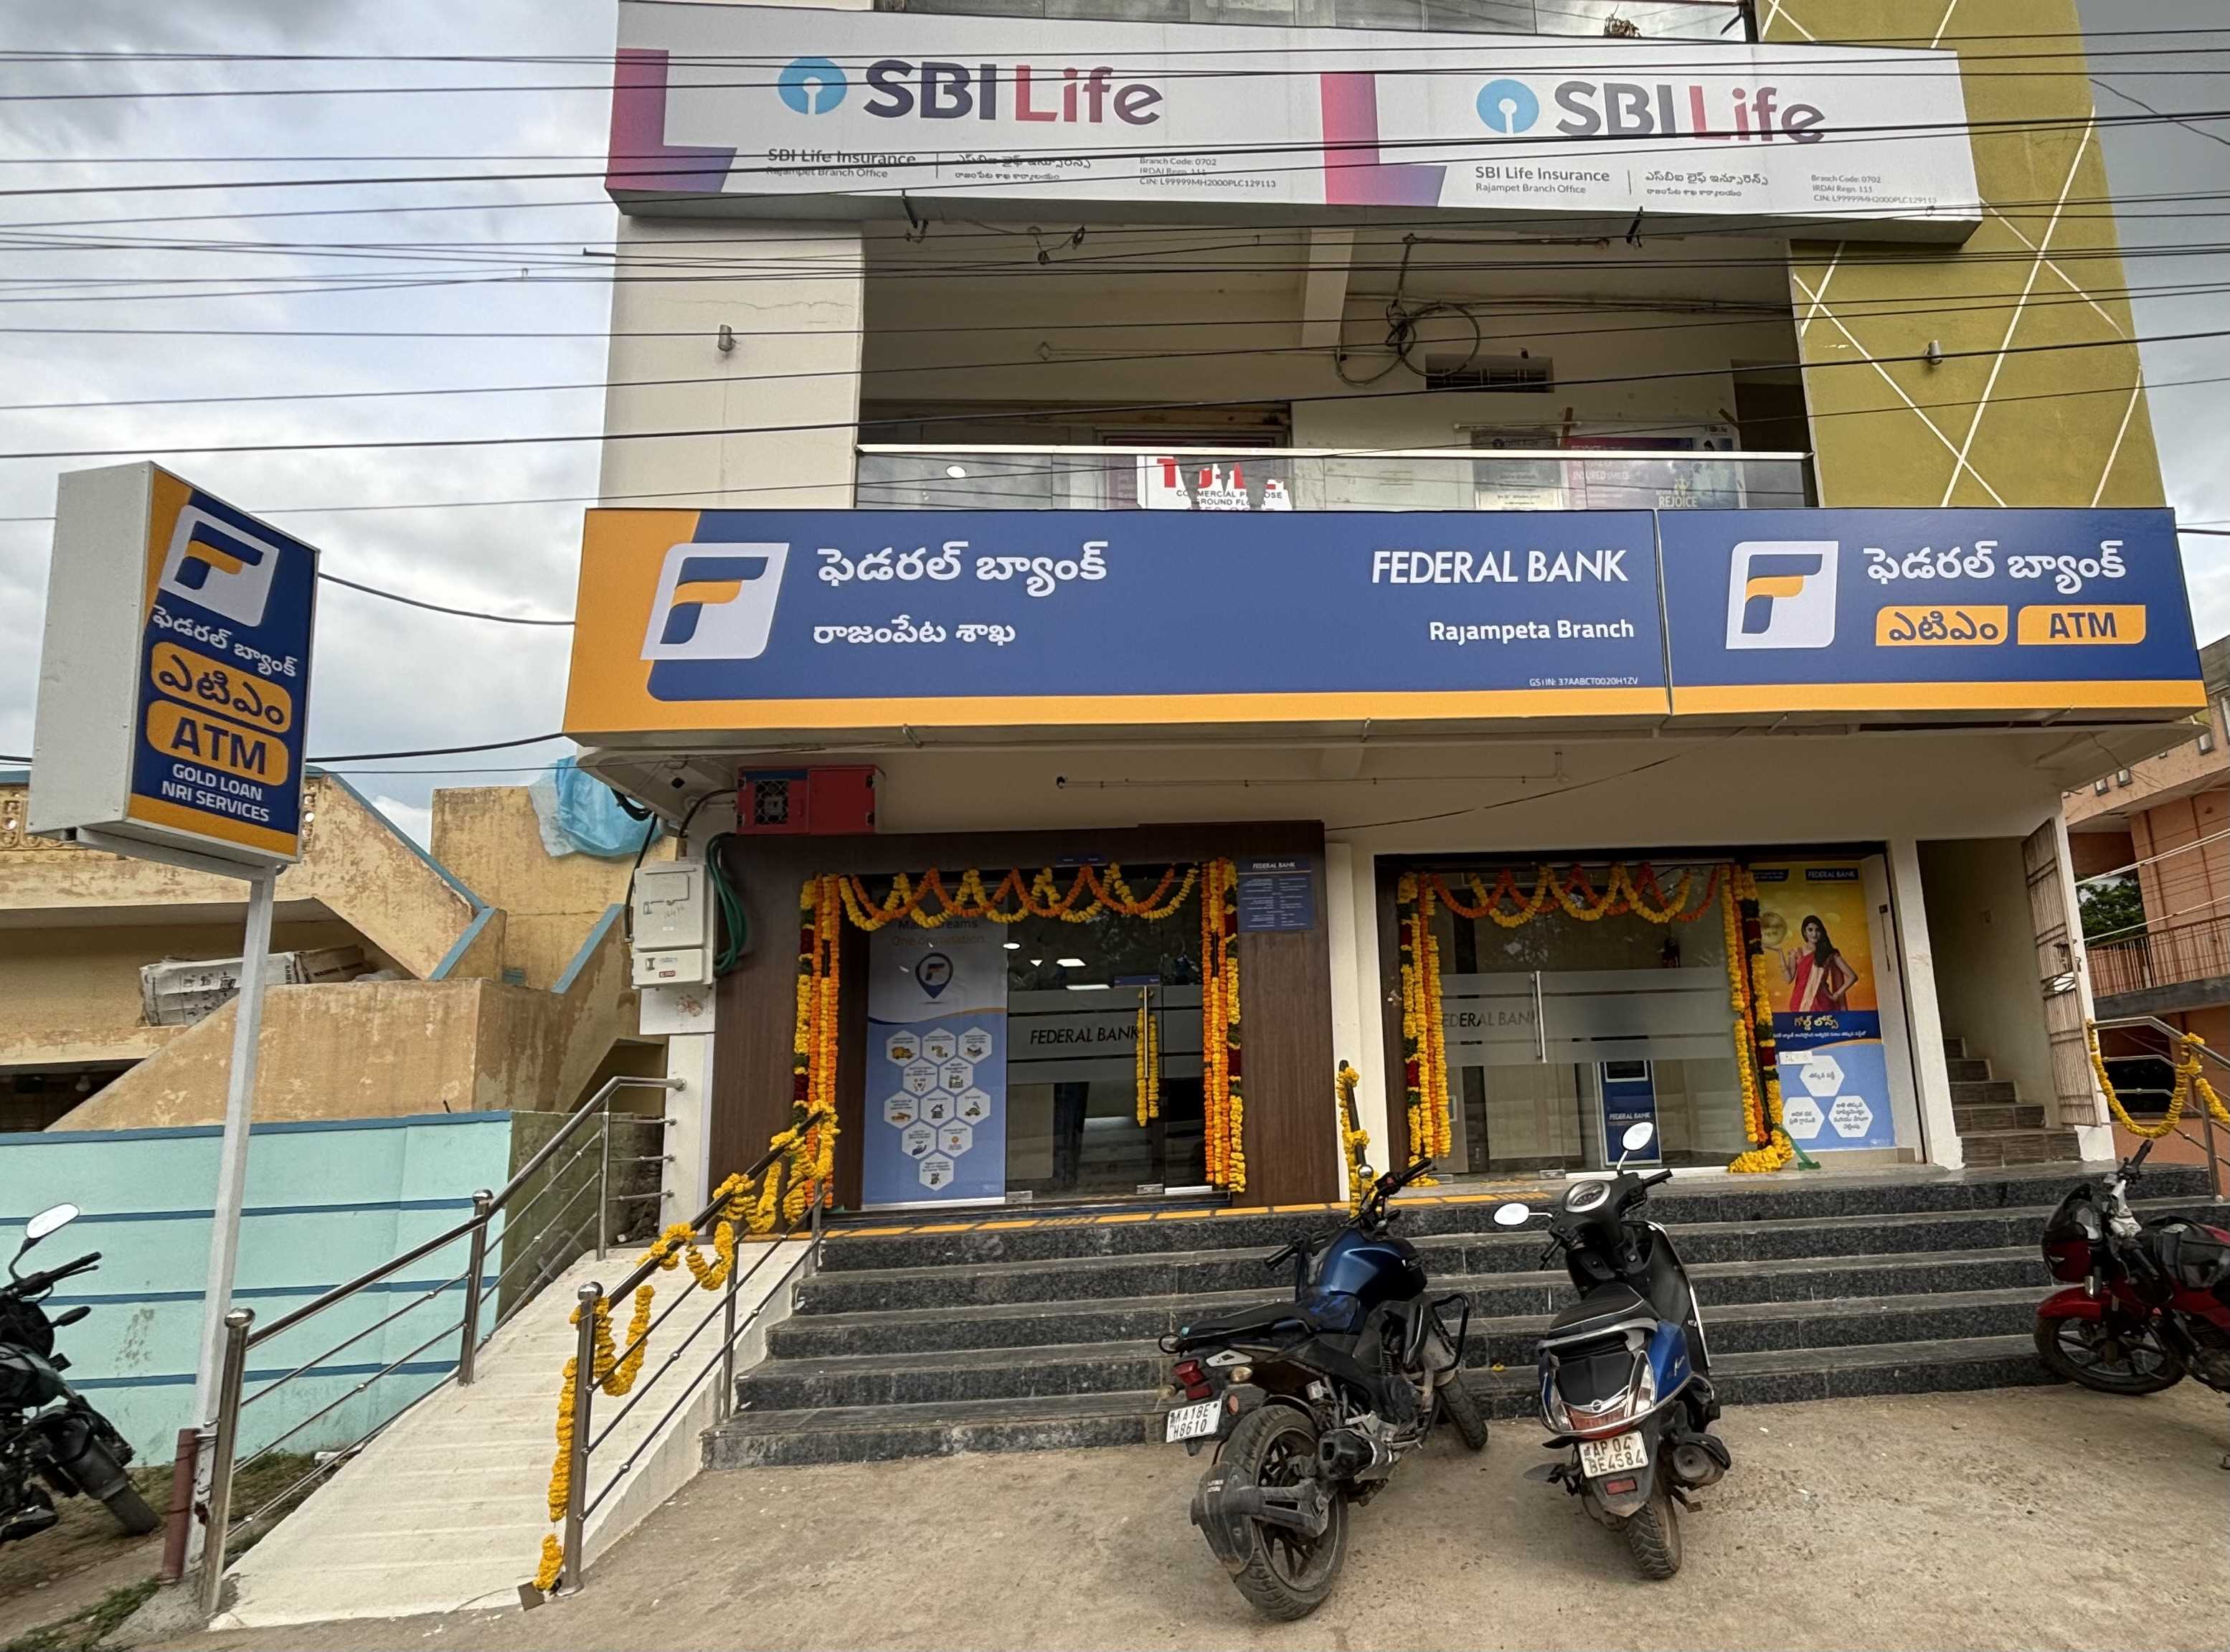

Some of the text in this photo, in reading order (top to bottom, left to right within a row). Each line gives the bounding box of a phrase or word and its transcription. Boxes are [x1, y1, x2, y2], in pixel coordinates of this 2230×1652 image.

[863, 59, 1163, 126] SBI Life
[1554, 80, 1825, 143] SBI Life
[767, 148, 917, 166] SBI Life Insurance
[818, 166, 854, 178] Branch
[856, 168, 888, 178] Office
[1475, 166, 1610, 181] SBI Life Insurance
[1475, 182, 1587, 194] Rajampet Branch Office
[1658, 496, 1699, 508] REJOICE
[817, 541, 1108, 597] ఫెడరల్ బ్యాంక్
[1371, 549, 1629, 584] FEDERAL BANK
[1863, 540, 2126, 594] ఫెడరల్ బ్యాంక్
[813, 614, 1016, 646] రాజంపేట శాఖ
[1430, 619, 1635, 646] Rajampeta Branch
[1889, 610, 1999, 642] ఎటిఎం
[2049, 612, 2117, 639] ATM
[152, 605, 298, 677] ఫెడరల్ బ్యాంక్
[159, 653, 285, 725] ఎటిఎం
[170, 717, 267, 775] ATM
[172, 763, 263, 801] GOLD LOAN
[161, 780, 270, 823] NRI SERVICES
[1442, 1012, 1496, 1027] EDERAL
[1029, 1025, 1139, 1045] FEDERAL BANK
[1176, 1403, 1211, 1422] KA18E
[1173, 1419, 1207, 1439] H8610
[1589, 1449, 1644, 1474] BE4584
[1593, 1440, 1607, 1458] AP
